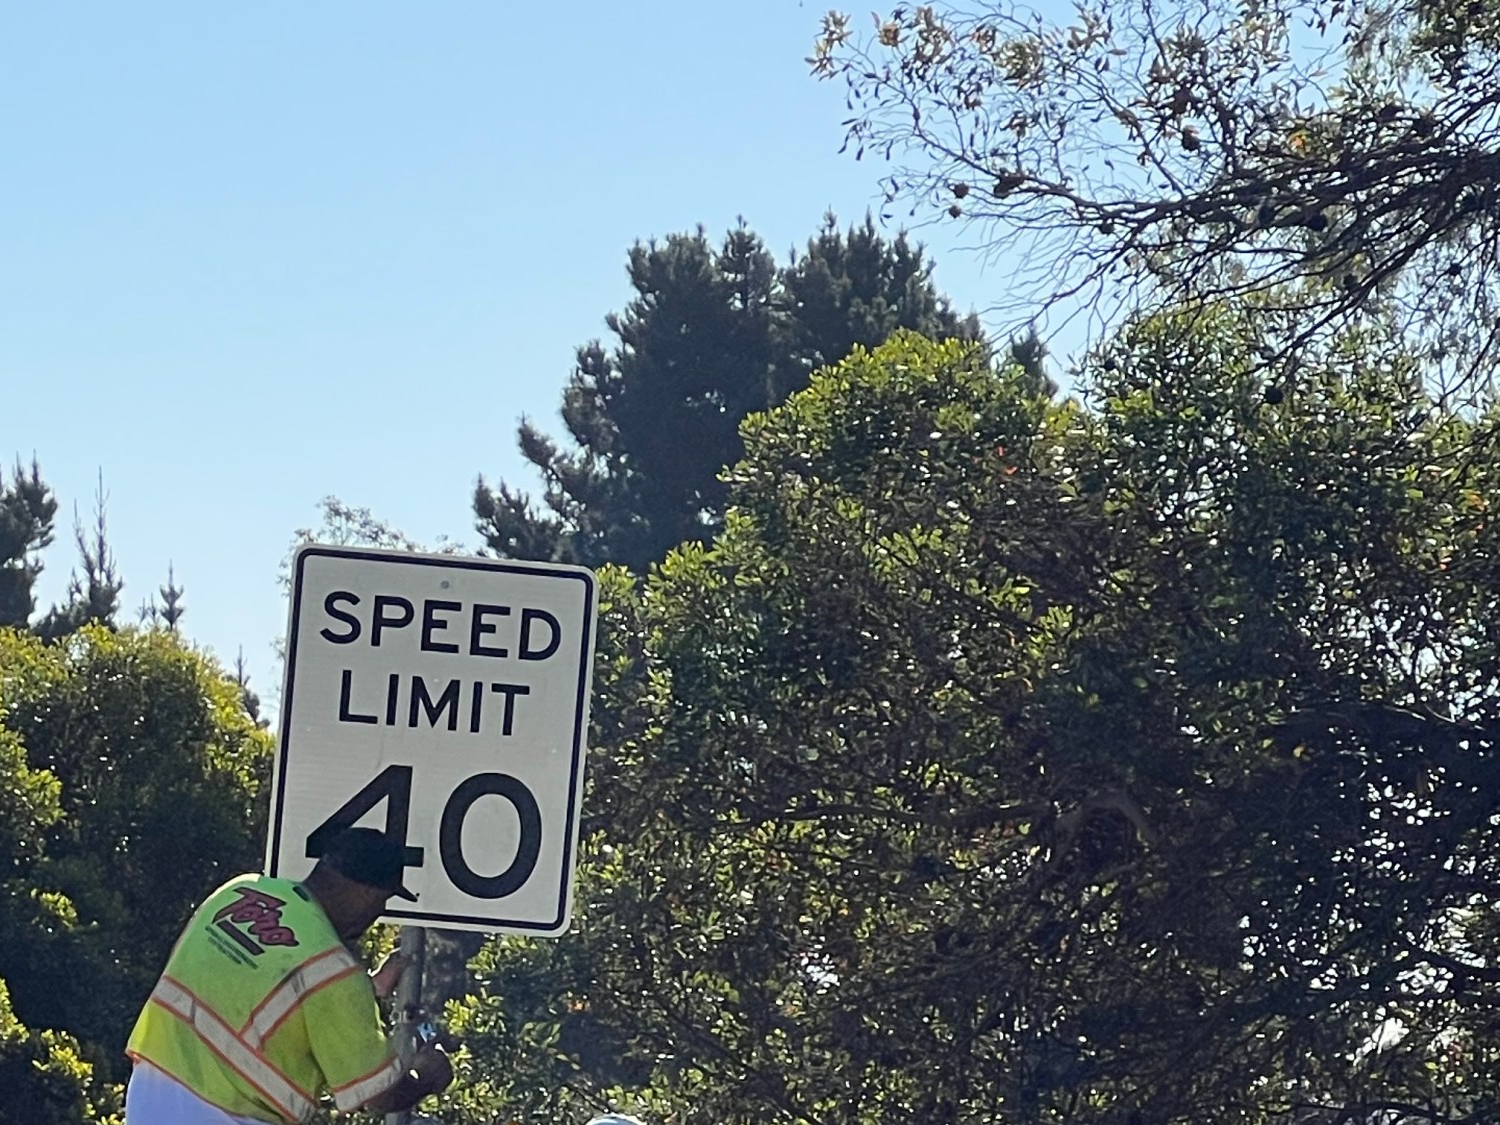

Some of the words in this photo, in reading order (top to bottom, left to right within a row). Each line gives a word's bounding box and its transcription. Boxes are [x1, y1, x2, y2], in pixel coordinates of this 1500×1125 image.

[319, 590, 562, 661] SPEED
[338, 669, 531, 736] LIMIT
[305, 764, 543, 900] 40
